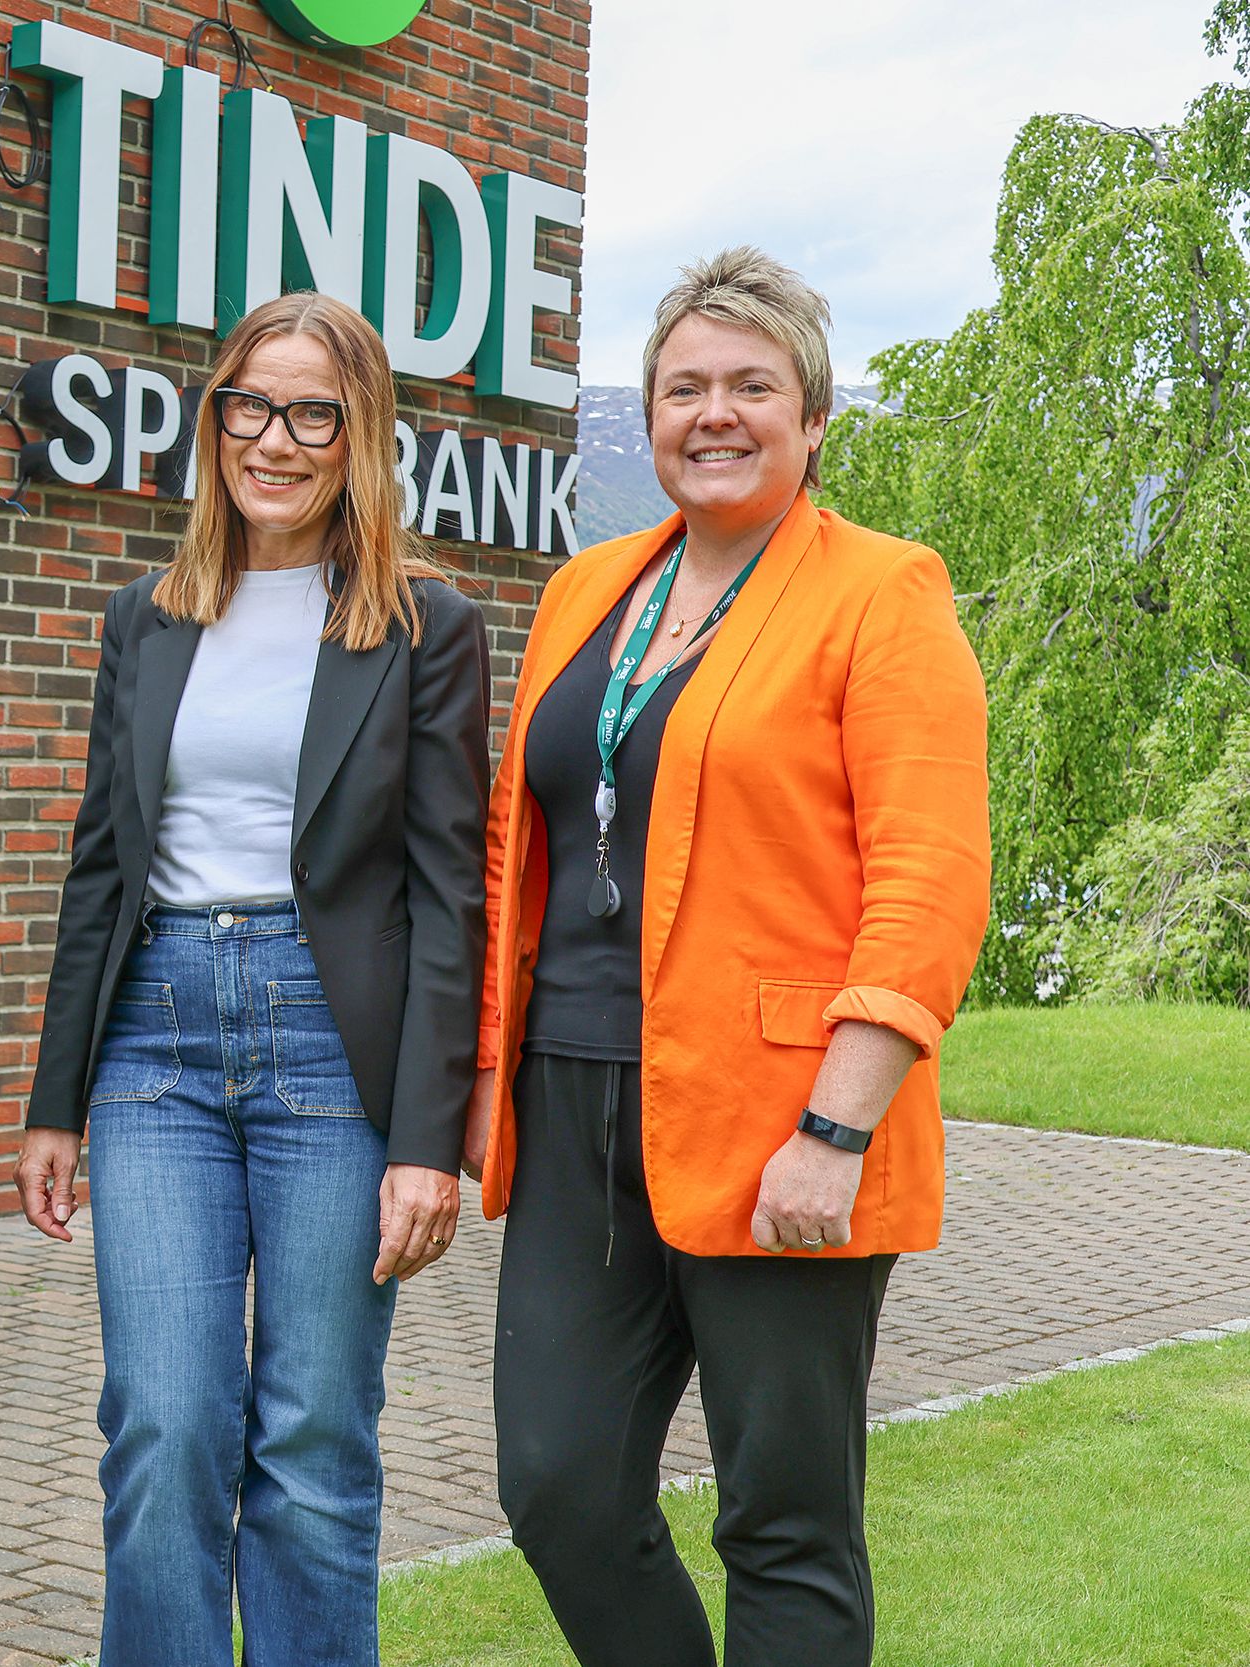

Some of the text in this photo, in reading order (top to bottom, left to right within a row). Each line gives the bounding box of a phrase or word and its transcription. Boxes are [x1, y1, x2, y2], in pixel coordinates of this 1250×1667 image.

[22, 19, 583, 410] TINDE
[47, 354, 583, 557] SPBANK
[717, 588, 738, 611] TINDE
[643, 611, 656, 630] TINDE
[618, 665, 632, 680] TINDE
[619, 706, 637, 730] TINDE
[604, 719, 614, 745] TINDE
